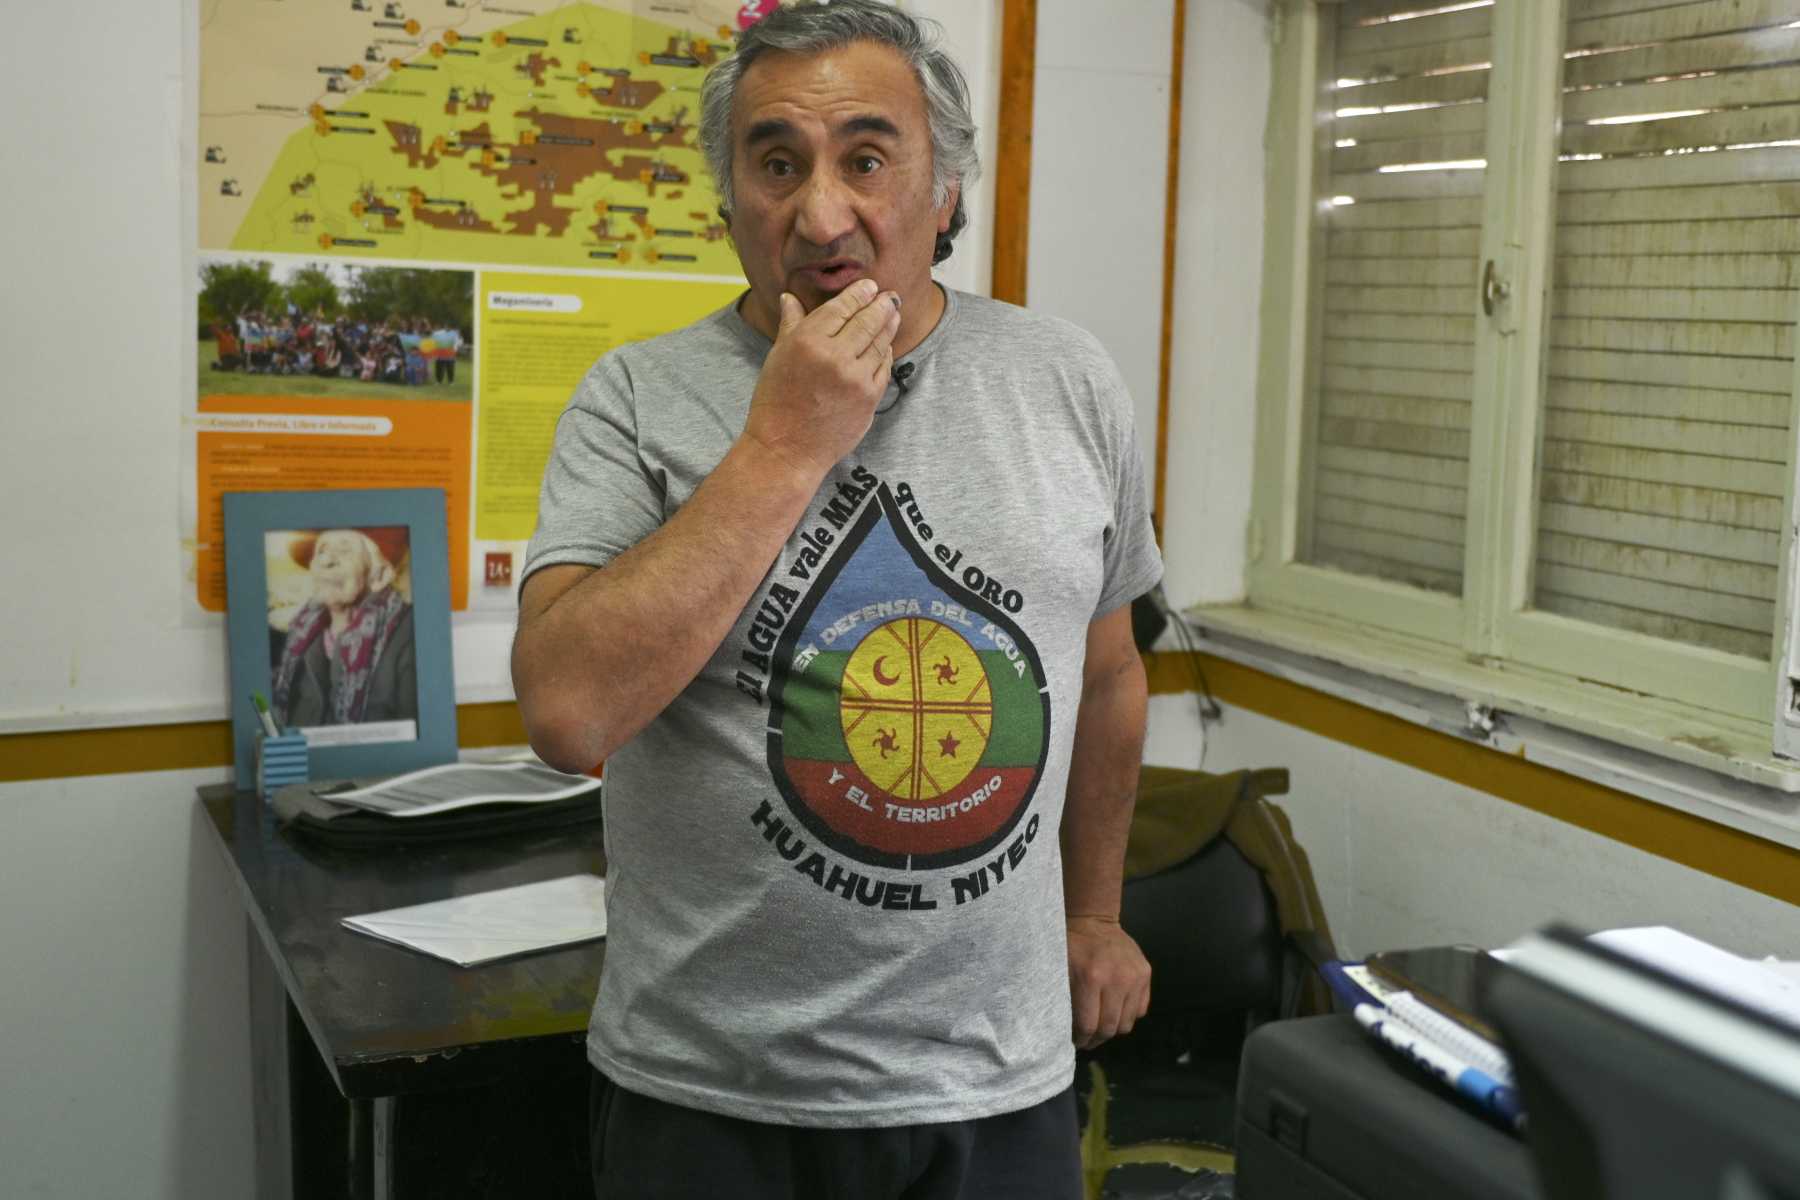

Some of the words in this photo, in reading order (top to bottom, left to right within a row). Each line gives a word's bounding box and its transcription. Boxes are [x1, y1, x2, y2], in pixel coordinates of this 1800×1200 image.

[742, 583, 800, 674] AGUA
[789, 527, 835, 580] vale
[819, 465, 879, 531] MÁS
[895, 482, 934, 542] que
[934, 544, 963, 573] el
[962, 566, 1024, 613] ORO
[792, 643, 820, 673] EN
[820, 599, 921, 645] DEFENSA
[931, 600, 972, 626] DEL
[980, 622, 1027, 679] AGUA
[828, 768, 845, 785] Y
[845, 785, 873, 812] EL
[884, 775, 1002, 823] TERRITORIO
[750, 799, 937, 911] HUAHUEL
[951, 813, 1040, 905] NIYEO
